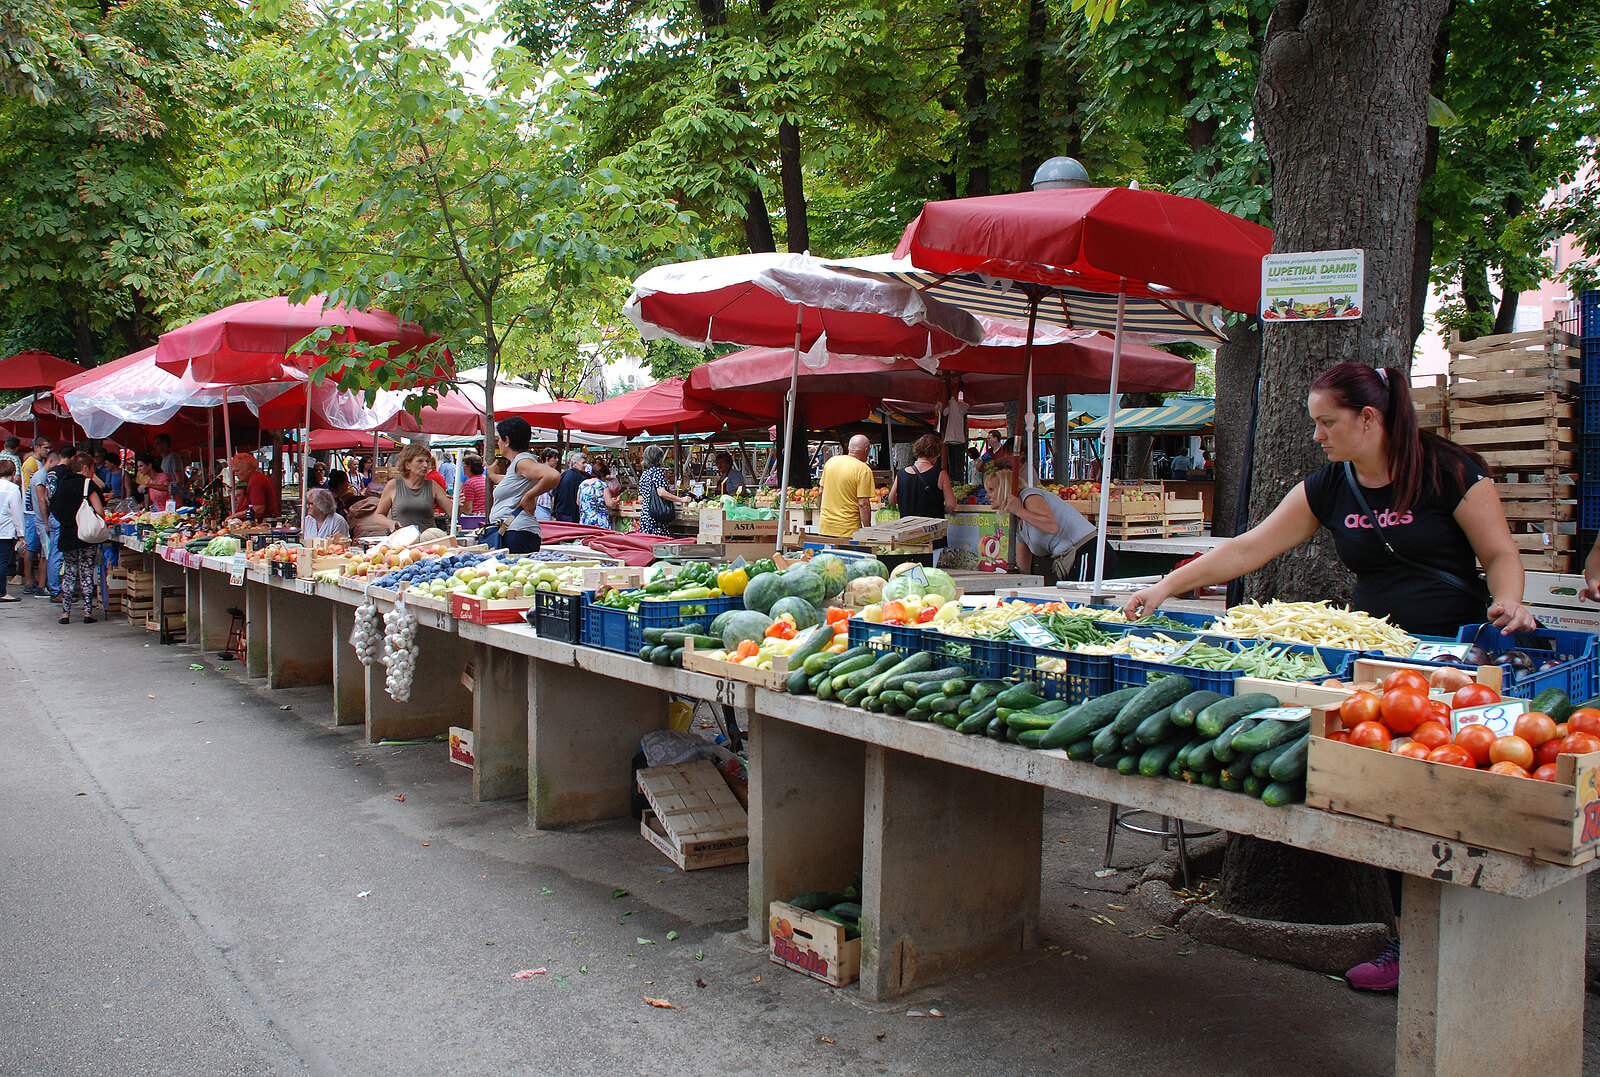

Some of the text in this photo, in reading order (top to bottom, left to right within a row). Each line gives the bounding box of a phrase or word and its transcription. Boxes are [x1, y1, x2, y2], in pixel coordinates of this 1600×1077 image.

[1268, 263, 1358, 277] LUPETINA DAMIR
[1344, 508, 1414, 528] adidas
[1532, 614, 1559, 624] STA
[716, 679, 735, 706] 26
[1483, 706, 1508, 733] 8
[1431, 841, 1489, 888] 27
[774, 936, 829, 977] Natalia
